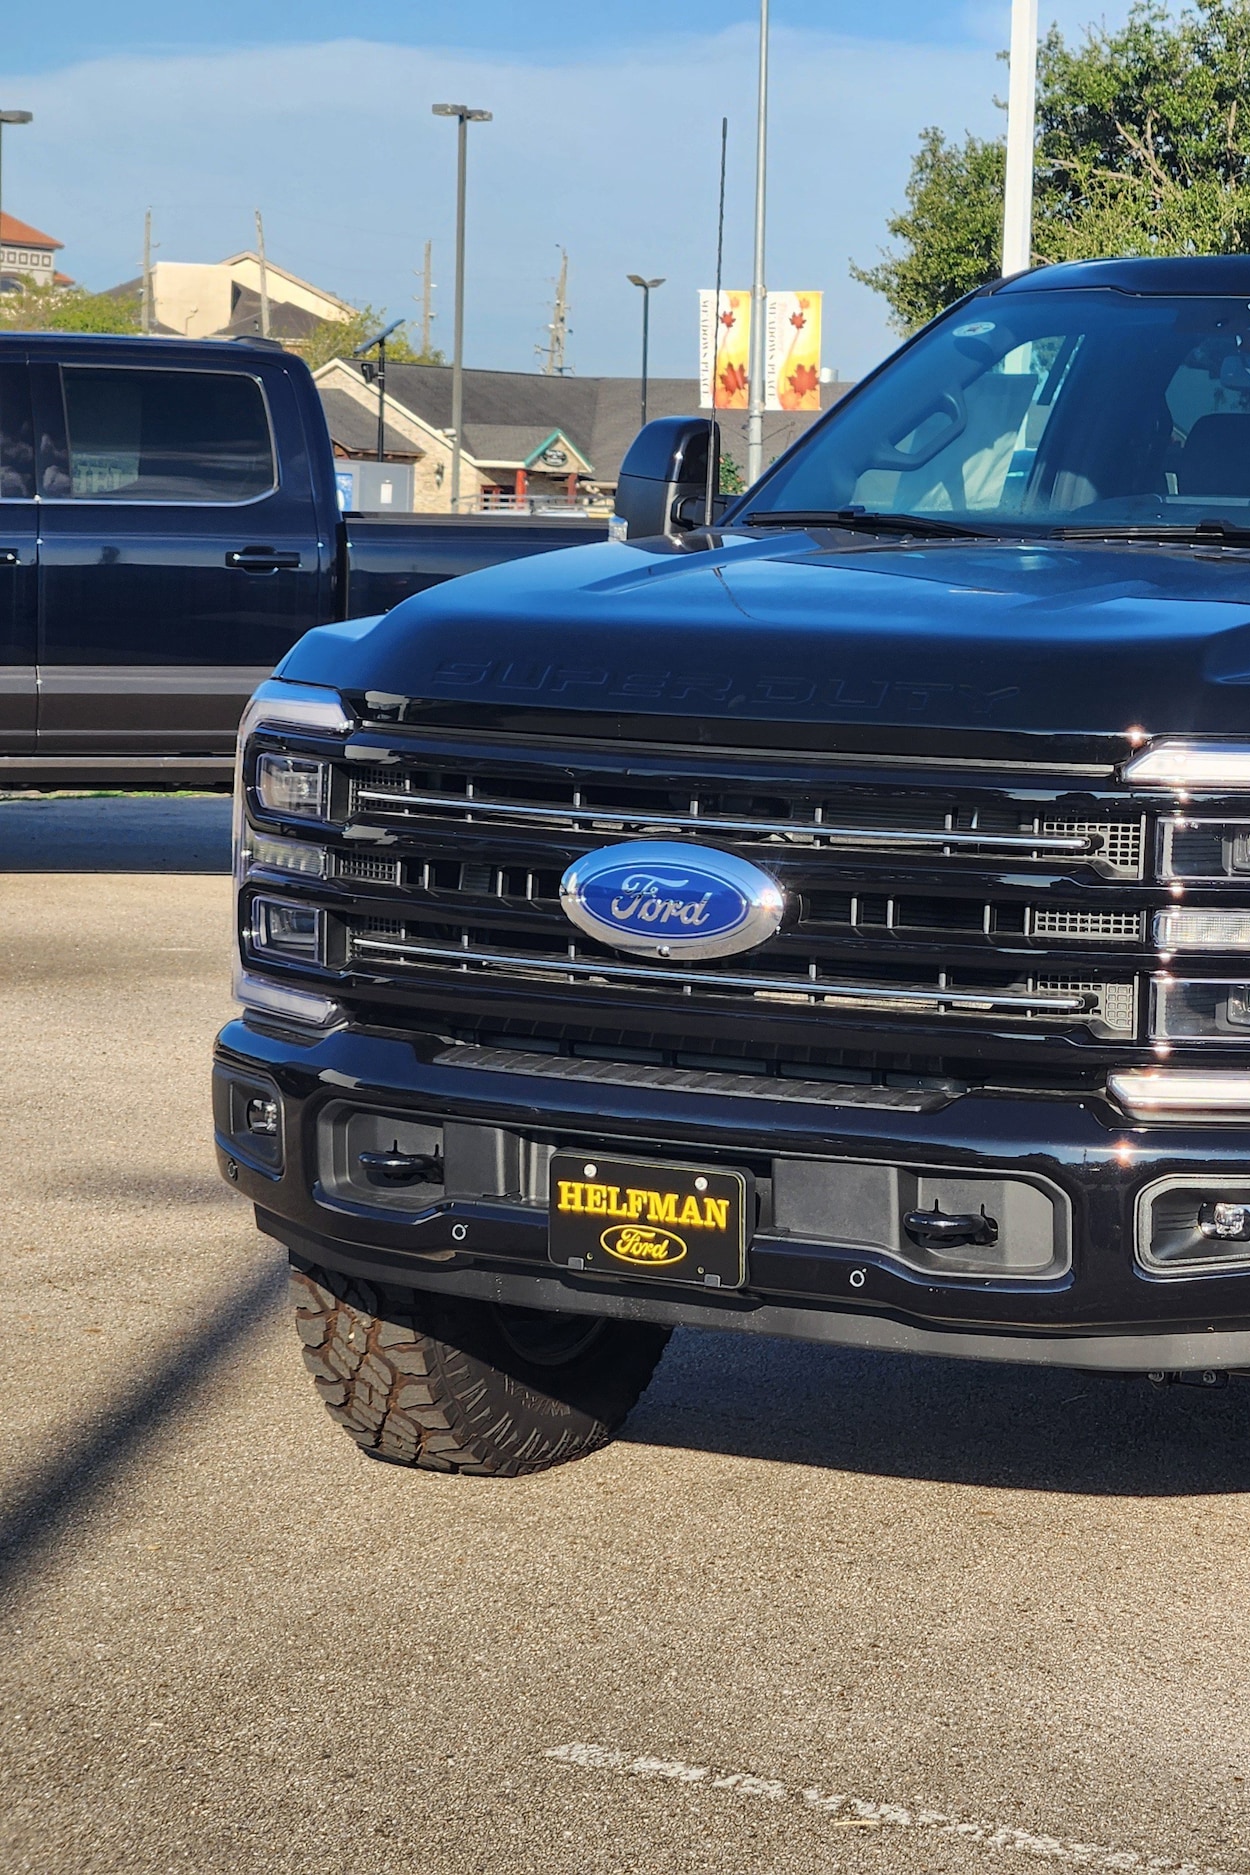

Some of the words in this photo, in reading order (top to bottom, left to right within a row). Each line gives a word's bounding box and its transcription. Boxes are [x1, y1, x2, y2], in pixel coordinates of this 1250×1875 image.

[701, 300, 709, 358] MEADOWS
[768, 301, 777, 360] MEADOWS
[701, 361, 709, 396] PLACE
[768, 363, 776, 398] PLACE
[430, 657, 736, 703] SUPER
[745, 674, 1023, 716] DUTY
[611, 872, 713, 926] Ford
[558, 1180, 730, 1229] HELFMAN
[615, 1228, 669, 1259] Ford
